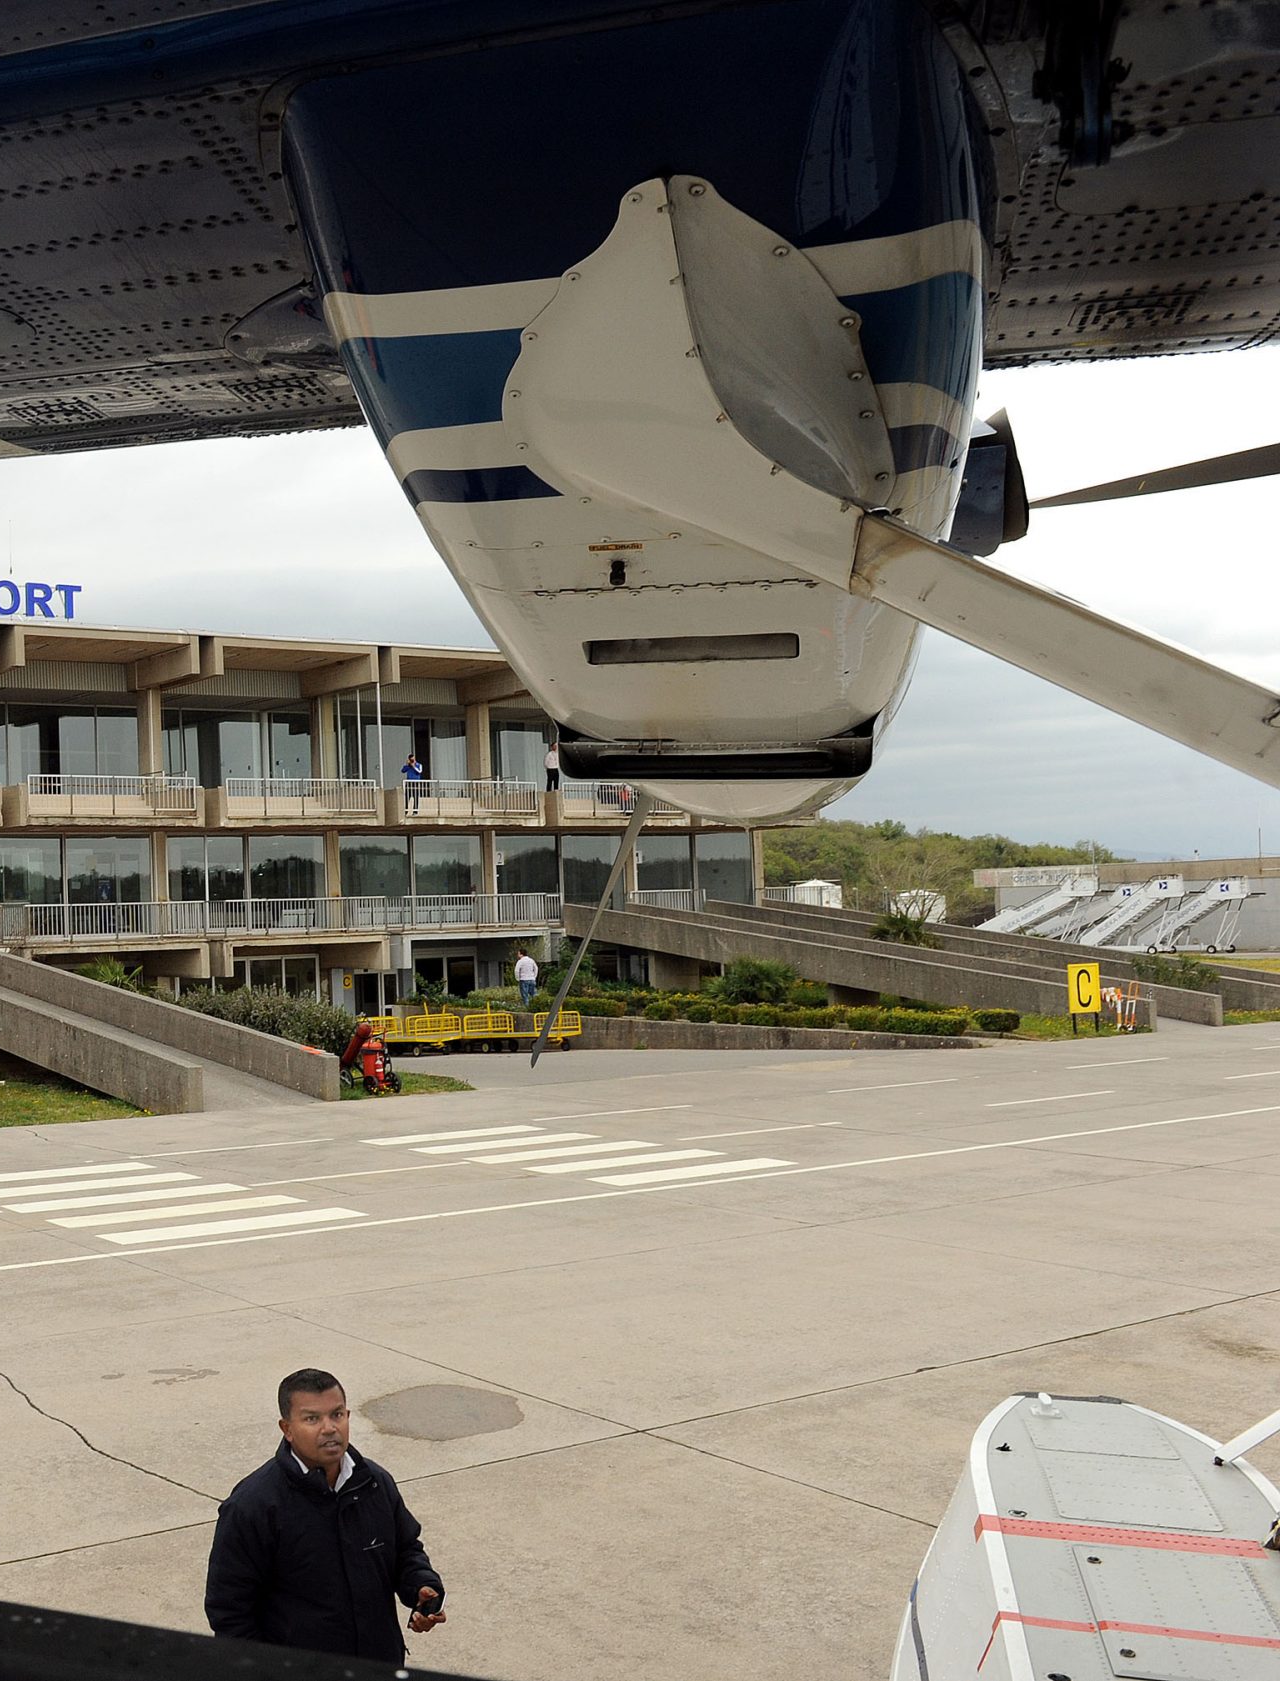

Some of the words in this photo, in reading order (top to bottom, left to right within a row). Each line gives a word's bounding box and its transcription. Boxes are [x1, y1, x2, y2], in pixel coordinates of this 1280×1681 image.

[497, 853, 502, 864] 2
[343, 976, 351, 987] C
[1077, 969, 1092, 1008] C
